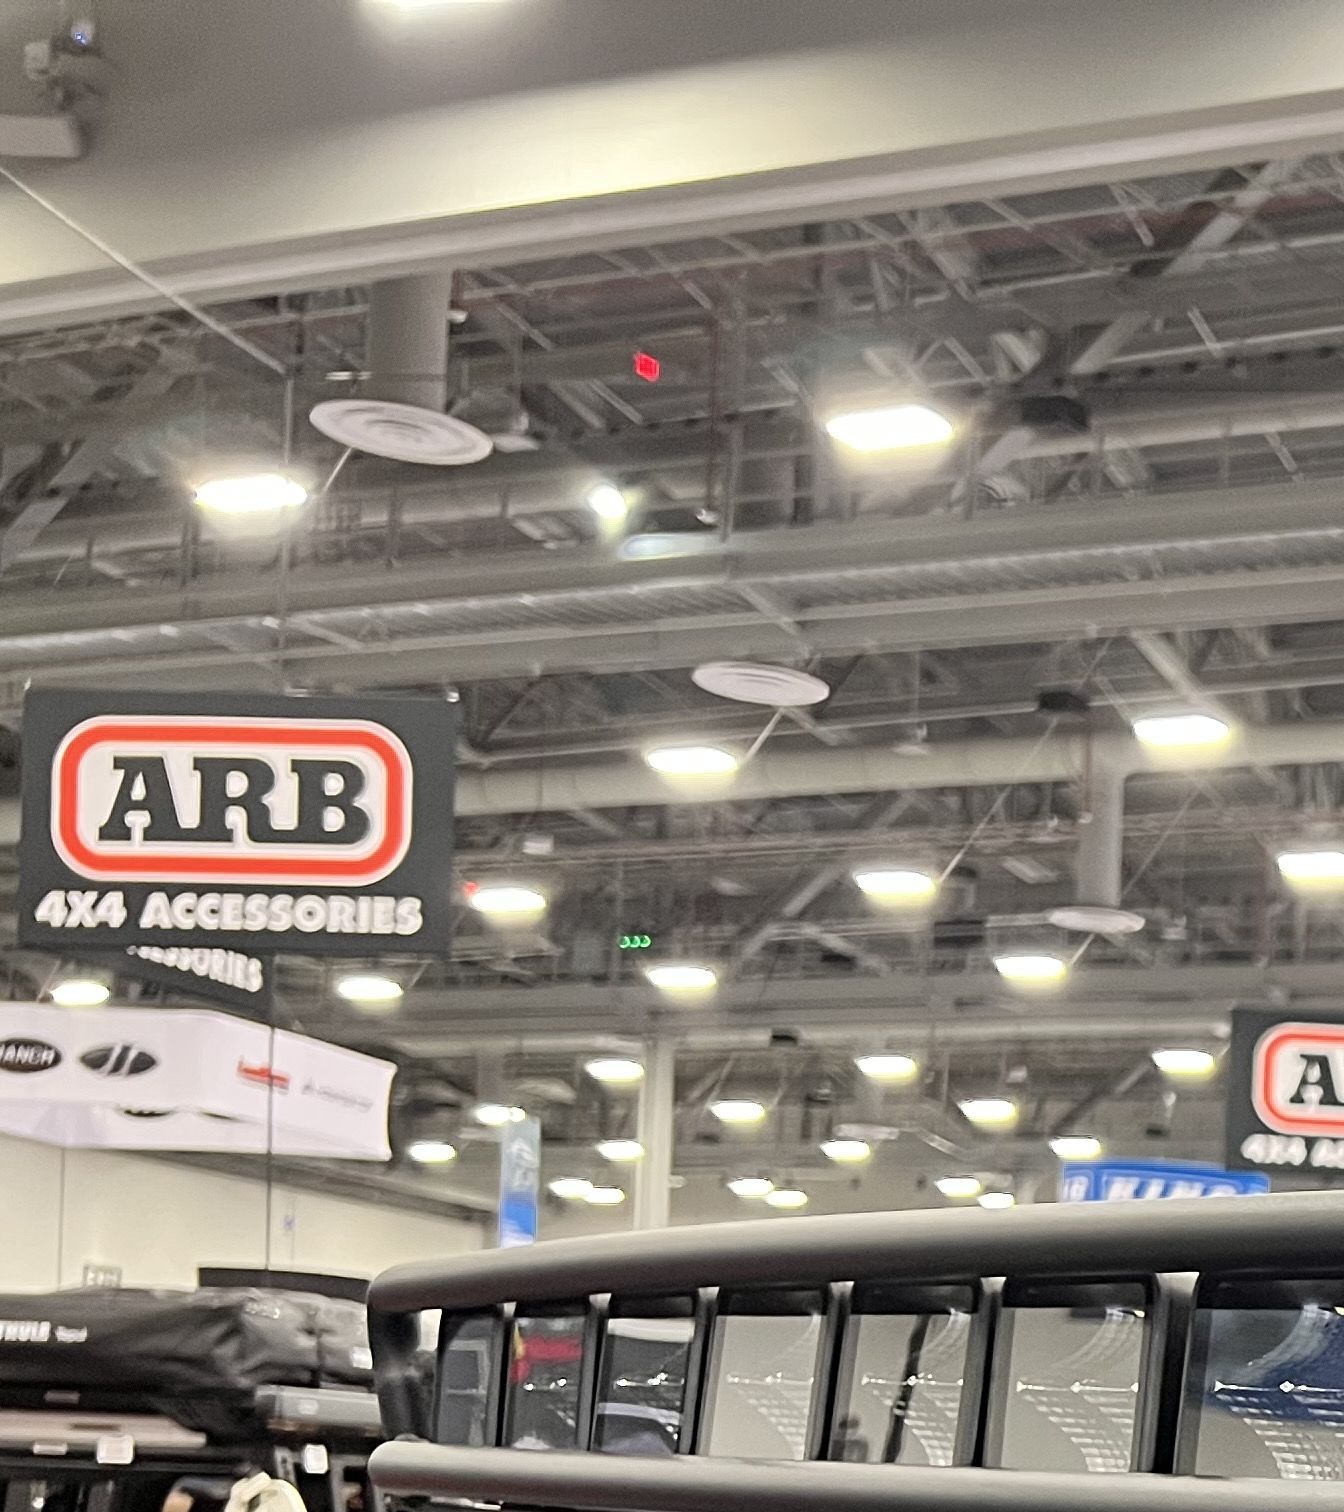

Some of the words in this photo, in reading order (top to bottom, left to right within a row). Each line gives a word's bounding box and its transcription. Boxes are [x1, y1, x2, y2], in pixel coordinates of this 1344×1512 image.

[98, 755, 371, 844] ARB
[34, 890, 128, 928] 4X4
[139, 892, 424, 936] ACCESSORIES
